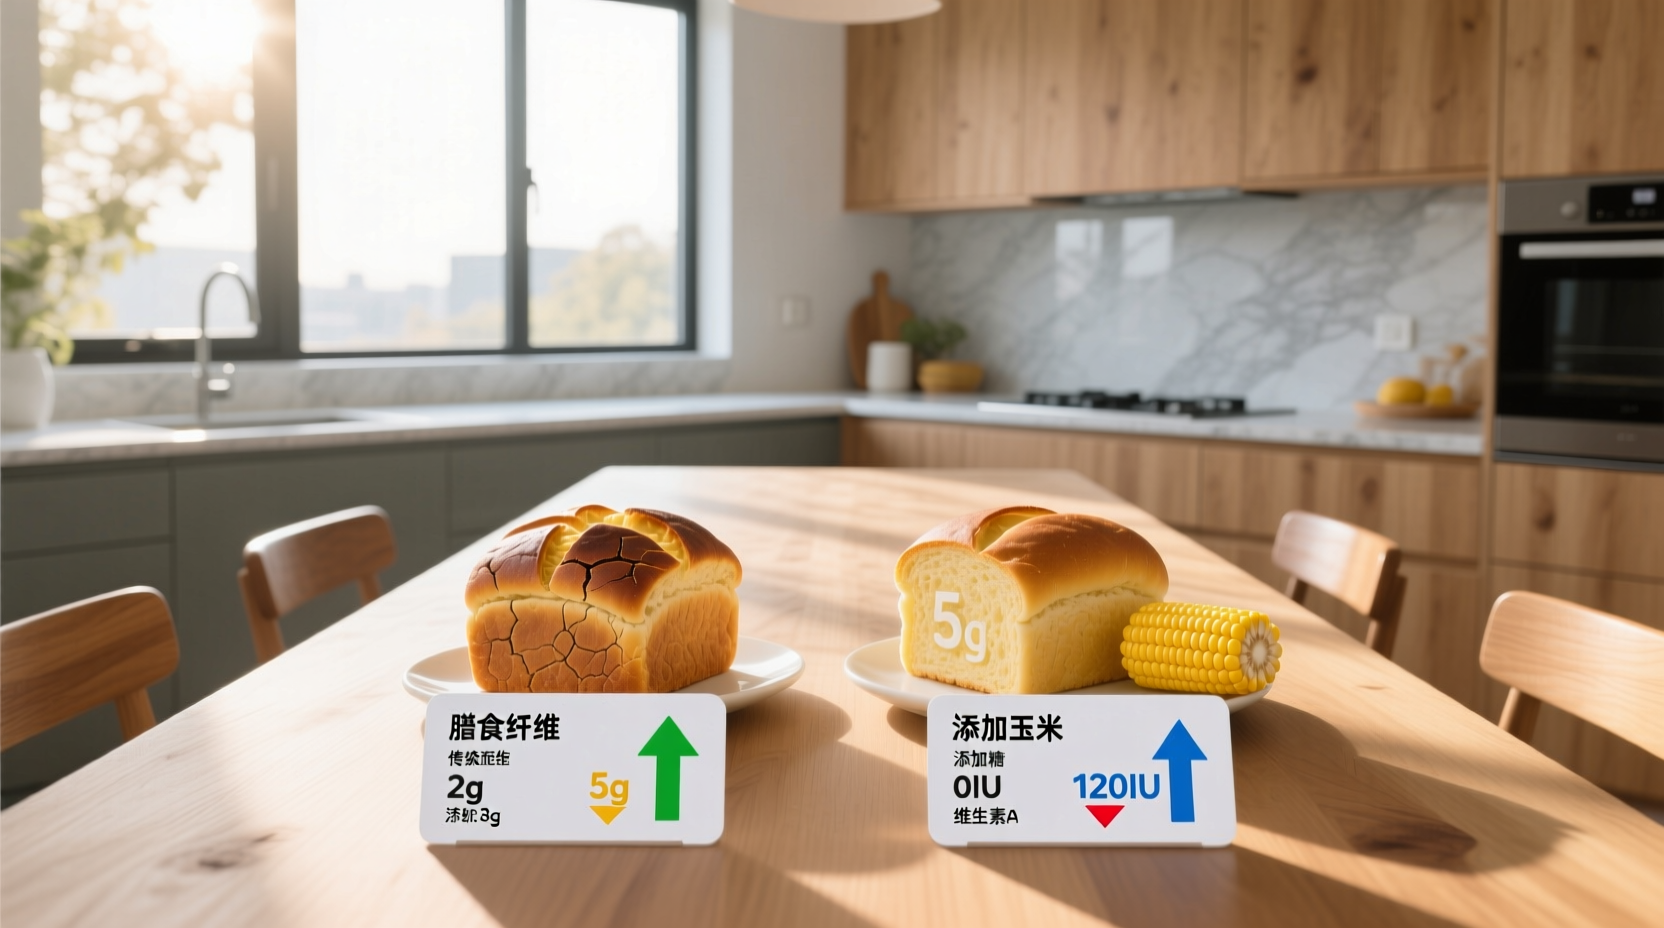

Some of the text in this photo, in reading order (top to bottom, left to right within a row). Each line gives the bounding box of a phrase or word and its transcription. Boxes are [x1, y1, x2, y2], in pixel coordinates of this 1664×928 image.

[933, 590, 987, 663] 5g
[952, 712, 1064, 742] 添加玉米
[953, 749, 1006, 768] 添加糖
[446, 774, 484, 804] 2g
[589, 771, 630, 805] 5g
[953, 774, 1002, 799] 0IU
[1072, 772, 1161, 800] 120IU
[953, 806, 1019, 826] 维生素A
